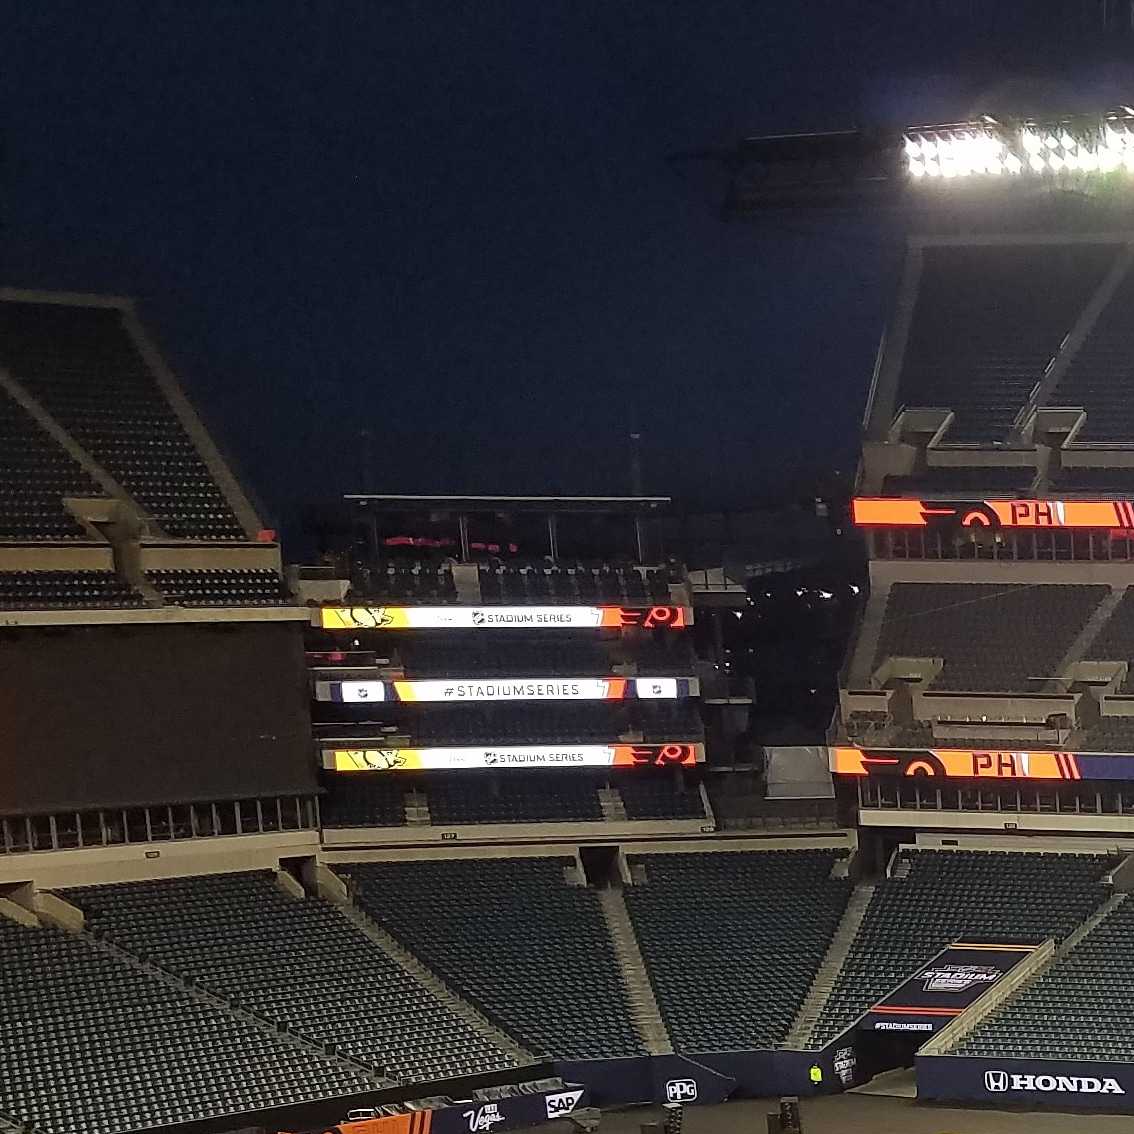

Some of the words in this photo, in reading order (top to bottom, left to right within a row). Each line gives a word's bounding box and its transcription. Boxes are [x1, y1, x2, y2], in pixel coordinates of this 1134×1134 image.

[487, 614, 534, 624] STADIUM
[536, 614, 572, 624] SERIES
[444, 684, 580, 698] #STADIUMSERIES
[499, 754, 547, 763] STADIUM
[549, 753, 584, 763] SERIES
[921, 971, 997, 981] STADIUM
[1010, 1074, 1125, 1094] HONDA
[669, 1082, 696, 1101] PPG
[548, 1096, 576, 1114] SAP
